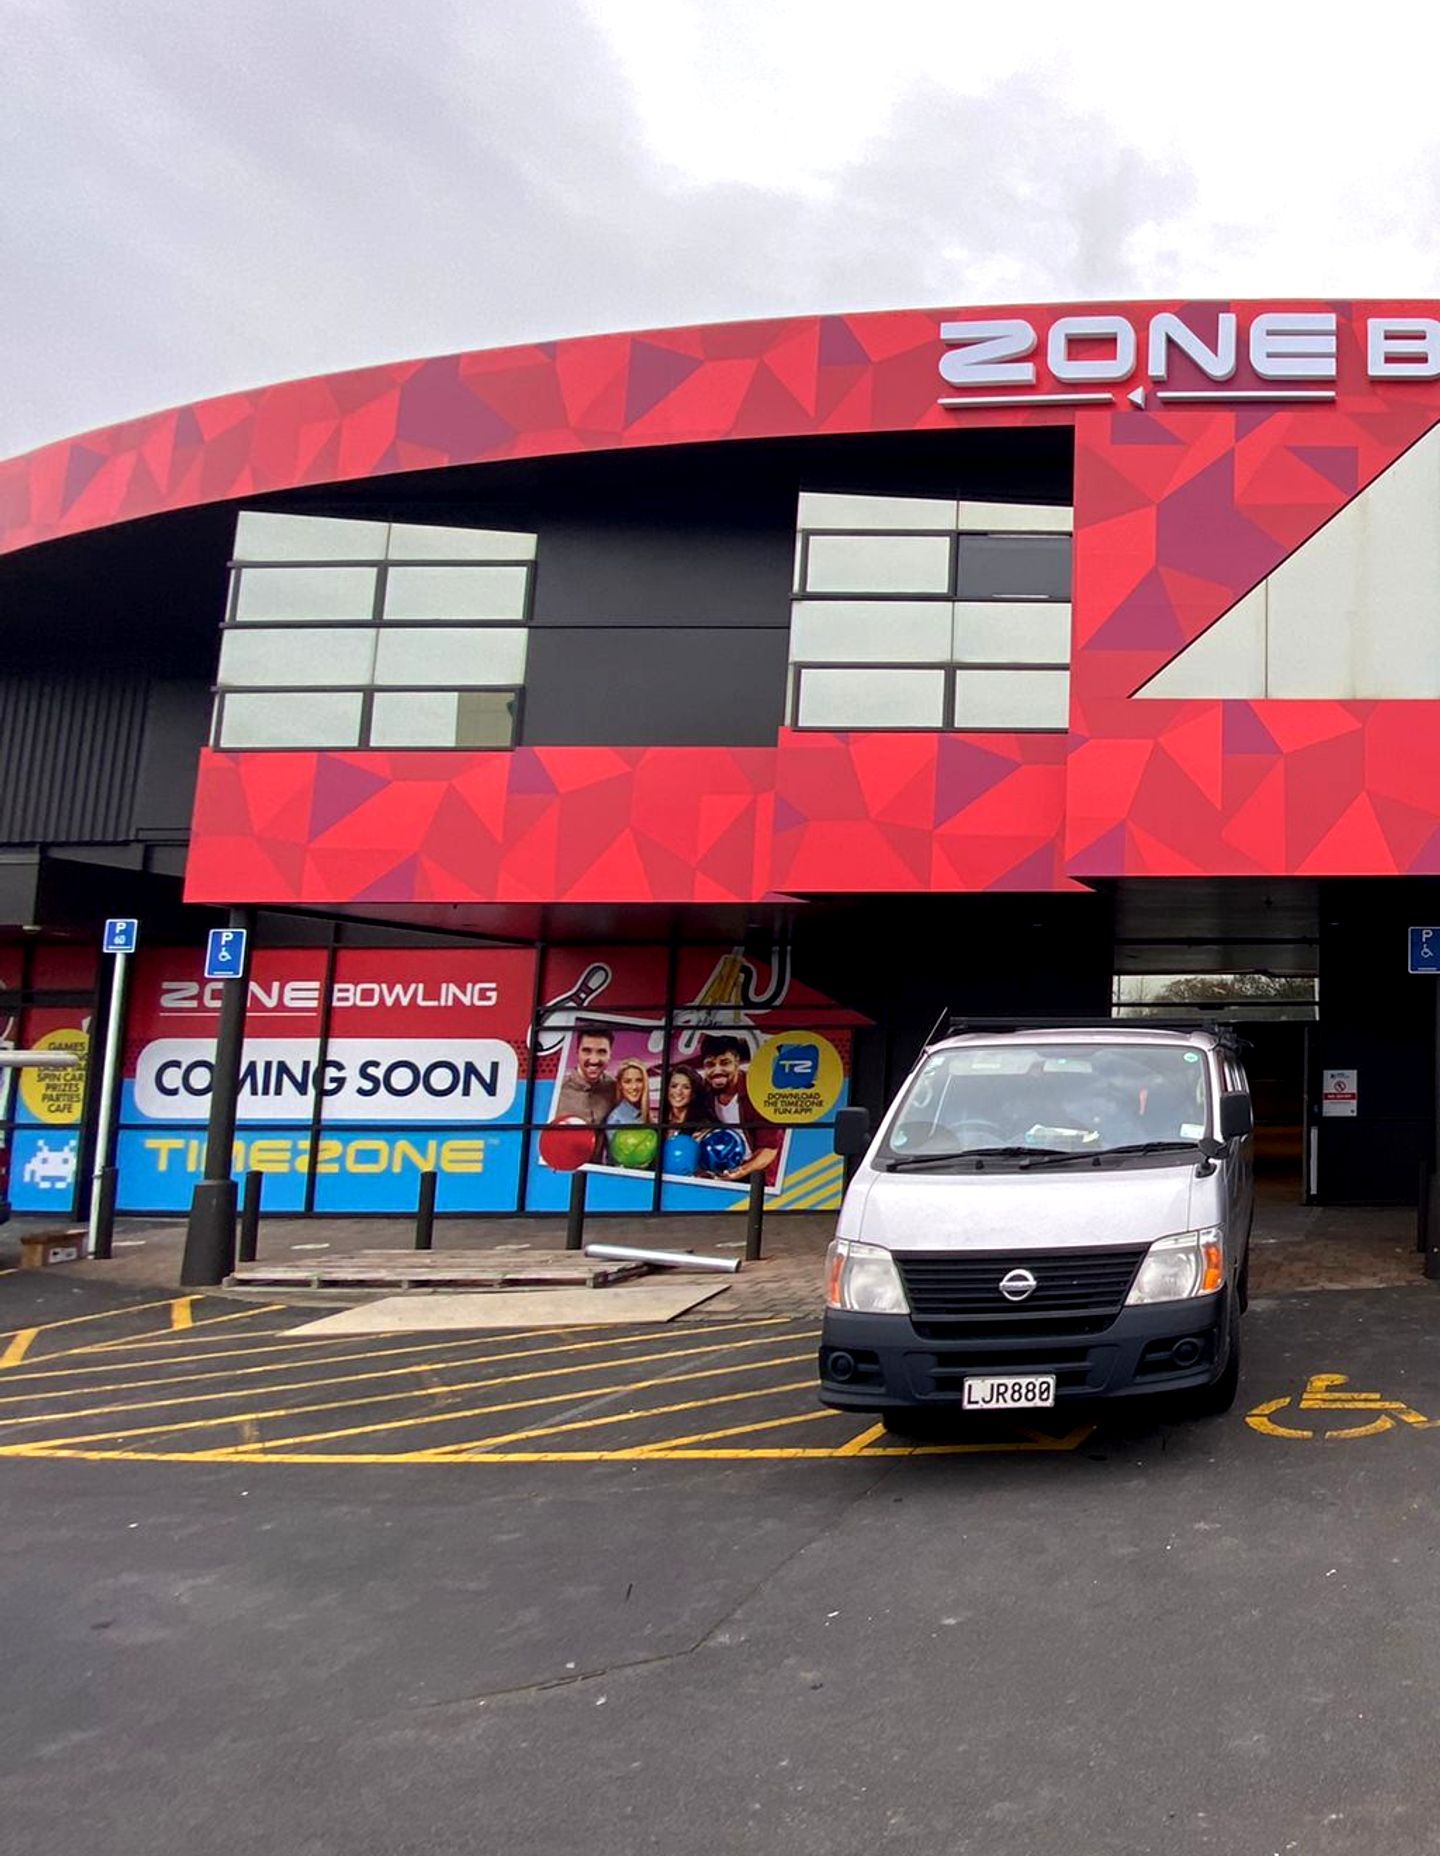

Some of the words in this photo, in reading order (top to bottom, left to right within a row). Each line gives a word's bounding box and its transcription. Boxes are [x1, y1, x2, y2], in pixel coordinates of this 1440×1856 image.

[938, 312, 1337, 387] ZONE
[116, 922, 127, 933] P
[114, 935, 126, 944] 60
[221, 932, 233, 945] P
[1422, 929, 1433, 942] P
[332, 982, 497, 1007] BOWLING
[356, 1060, 500, 1097] SOON
[45, 1082, 80, 1092] PRIZES
[41, 1092, 81, 1103] PARTIES
[768, 1092, 821, 1100] DOWNLOAD
[763, 1100, 779, 1108] THE
[780, 1100, 824, 1108] TIMEZONE
[773, 1107, 792, 1115] FUN
[967, 1380, 1051, 1405] LJR880
